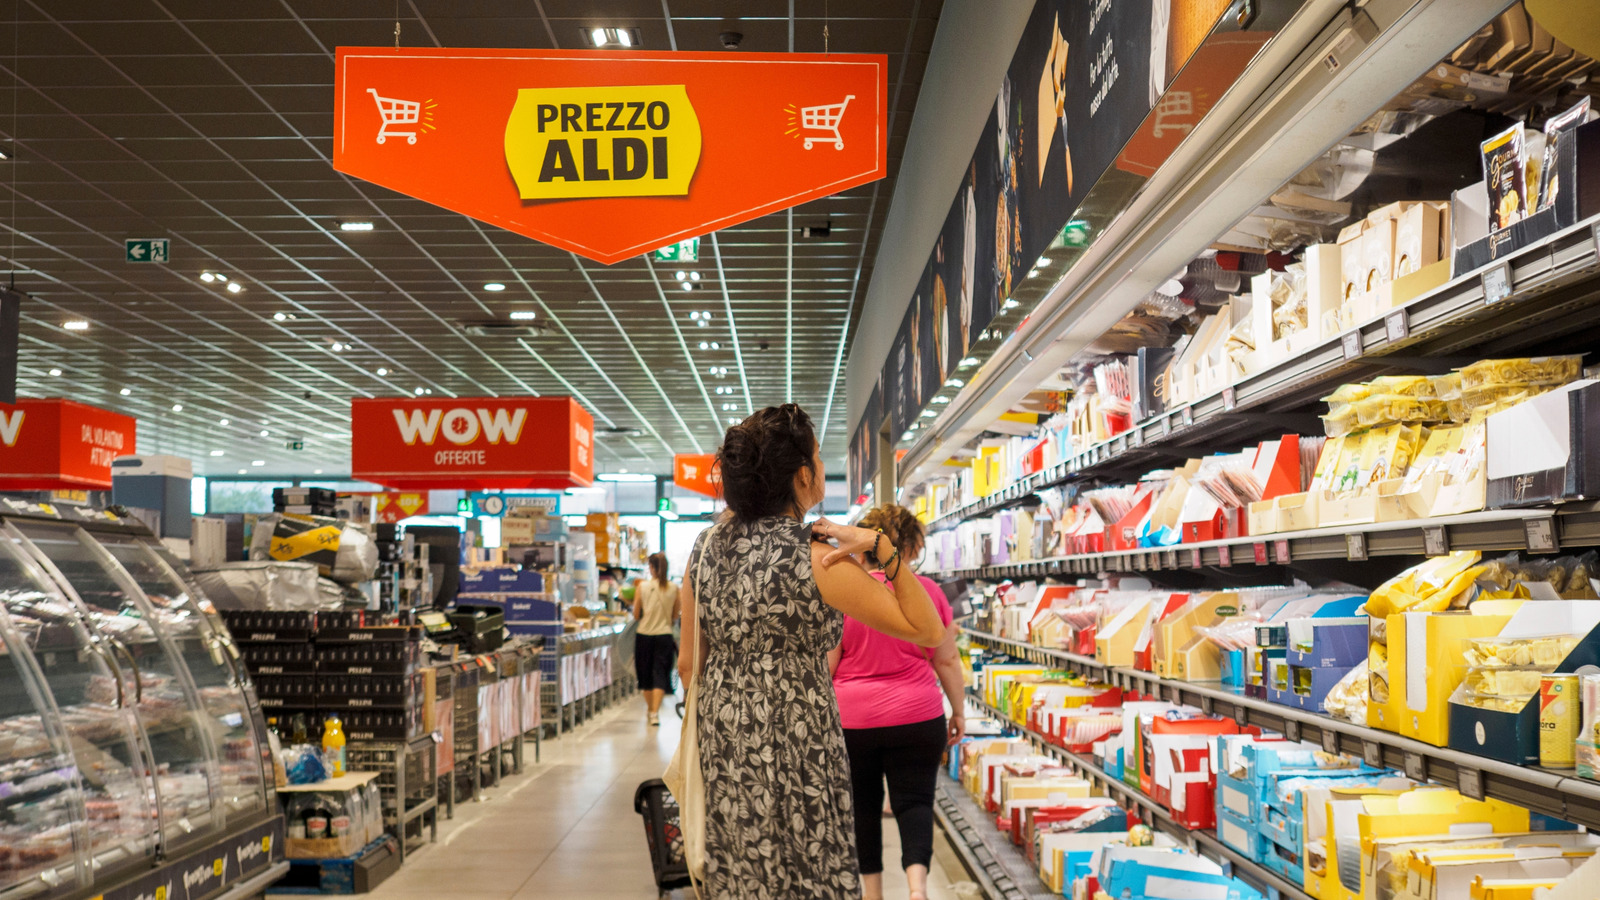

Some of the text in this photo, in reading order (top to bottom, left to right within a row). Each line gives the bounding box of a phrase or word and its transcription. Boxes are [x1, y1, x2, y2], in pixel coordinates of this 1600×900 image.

[536, 99, 671, 133] PREZZO
[538, 136, 669, 183] ALDI
[392, 408, 528, 445] WOW
[434, 450, 486, 466] OFFERTE
